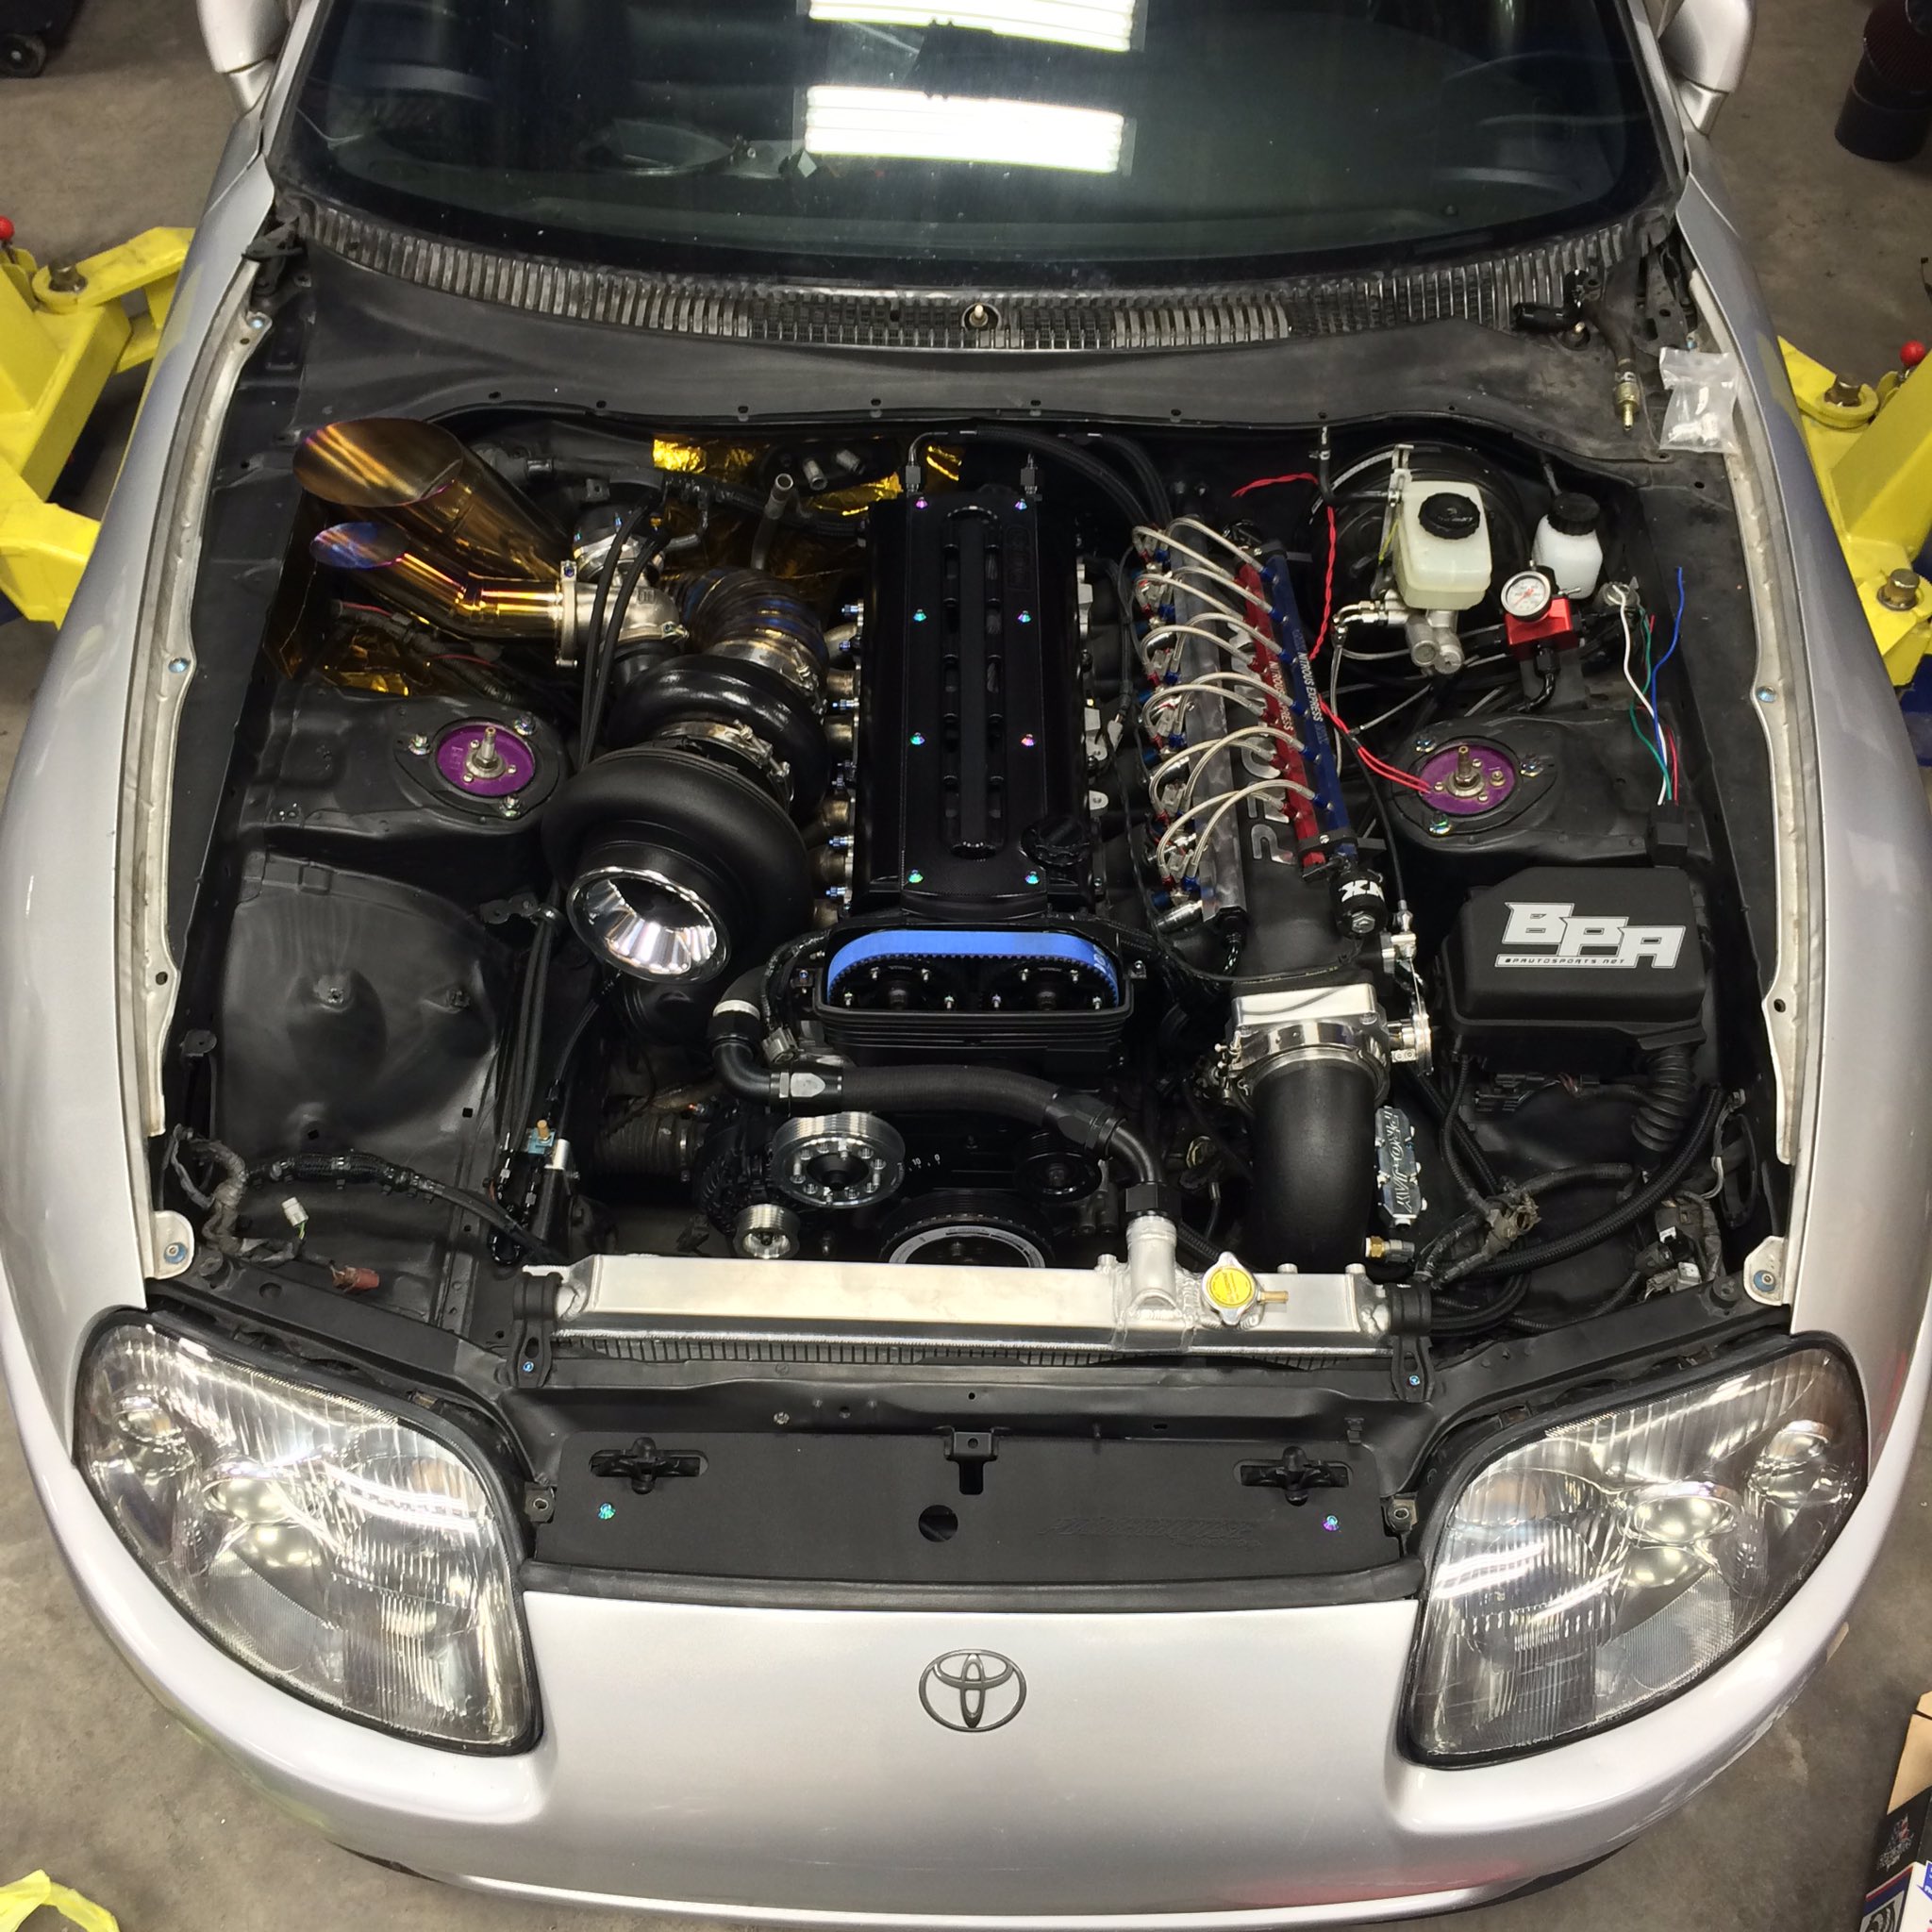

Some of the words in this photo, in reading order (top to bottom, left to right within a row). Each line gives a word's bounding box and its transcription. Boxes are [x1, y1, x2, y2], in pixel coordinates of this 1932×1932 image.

[1297, 651, 1314, 687] NITROUS
[1306, 685, 1324, 723] EXPRESS
[1502, 902, 1686, 968] BPA
[911, 1157, 922, 1166] 10
